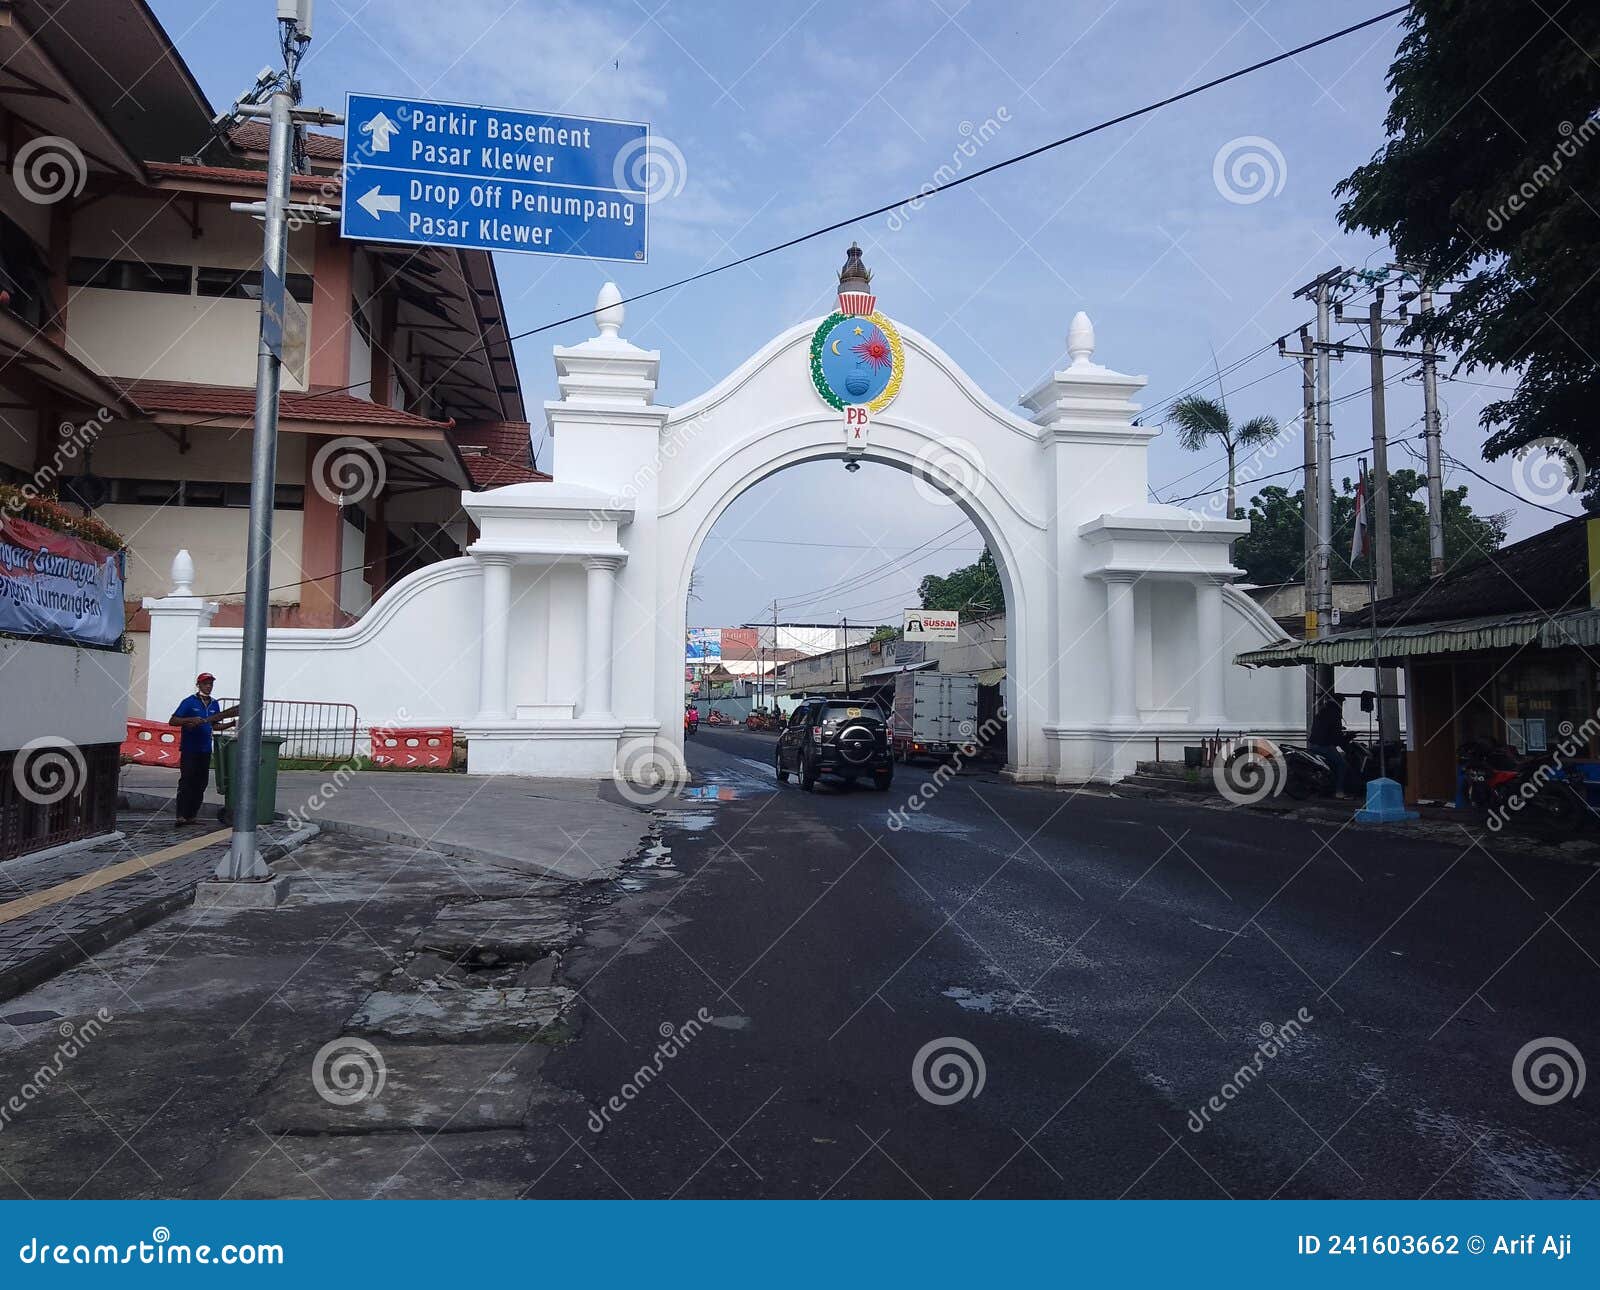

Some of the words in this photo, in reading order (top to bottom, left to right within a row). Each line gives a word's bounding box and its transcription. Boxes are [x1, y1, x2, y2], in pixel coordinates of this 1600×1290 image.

[412, 110, 477, 137] Parkir
[487, 117, 591, 149] Basement
[411, 140, 472, 166] Pasar
[481, 147, 555, 174] Klewer
[409, 179, 460, 210] Drop
[470, 185, 502, 209] Off
[511, 191, 634, 226] Penumpang
[409, 212, 470, 239] Pasar
[479, 218, 553, 245] Klewer
[846, 407, 868, 425] PB
[854, 427, 861, 439] X
[923, 619, 957, 627] SUSSAN
